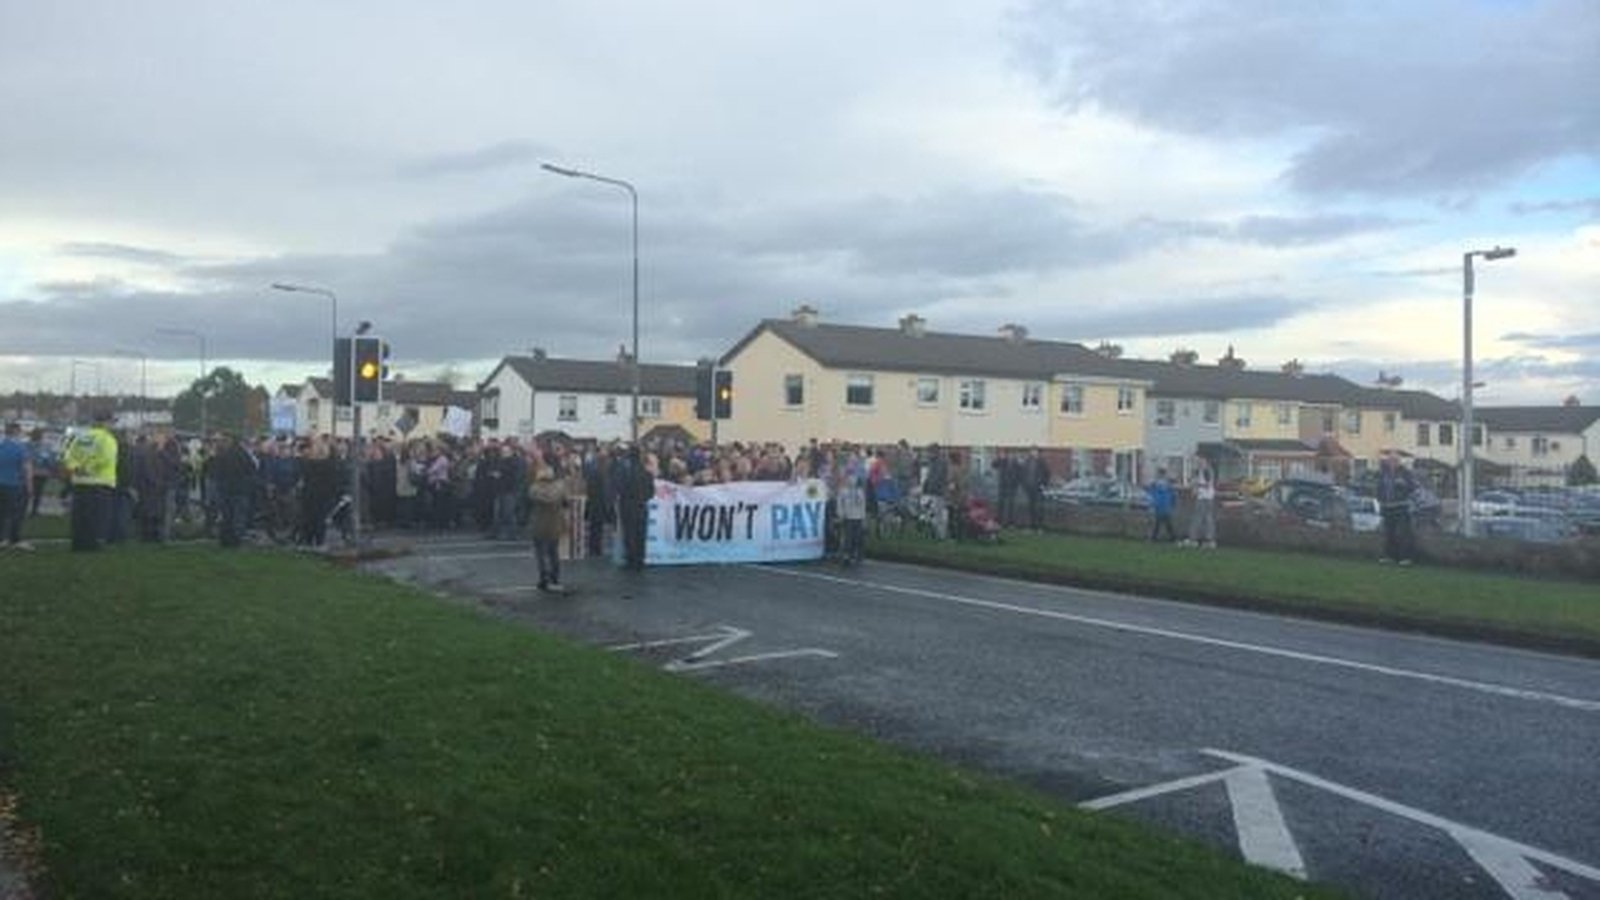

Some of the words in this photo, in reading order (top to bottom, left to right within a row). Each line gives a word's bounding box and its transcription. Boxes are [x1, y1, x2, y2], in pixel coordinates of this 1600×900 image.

[645, 504, 657, 541] E
[674, 501, 758, 541] WON'T
[771, 502, 823, 539] PAY
